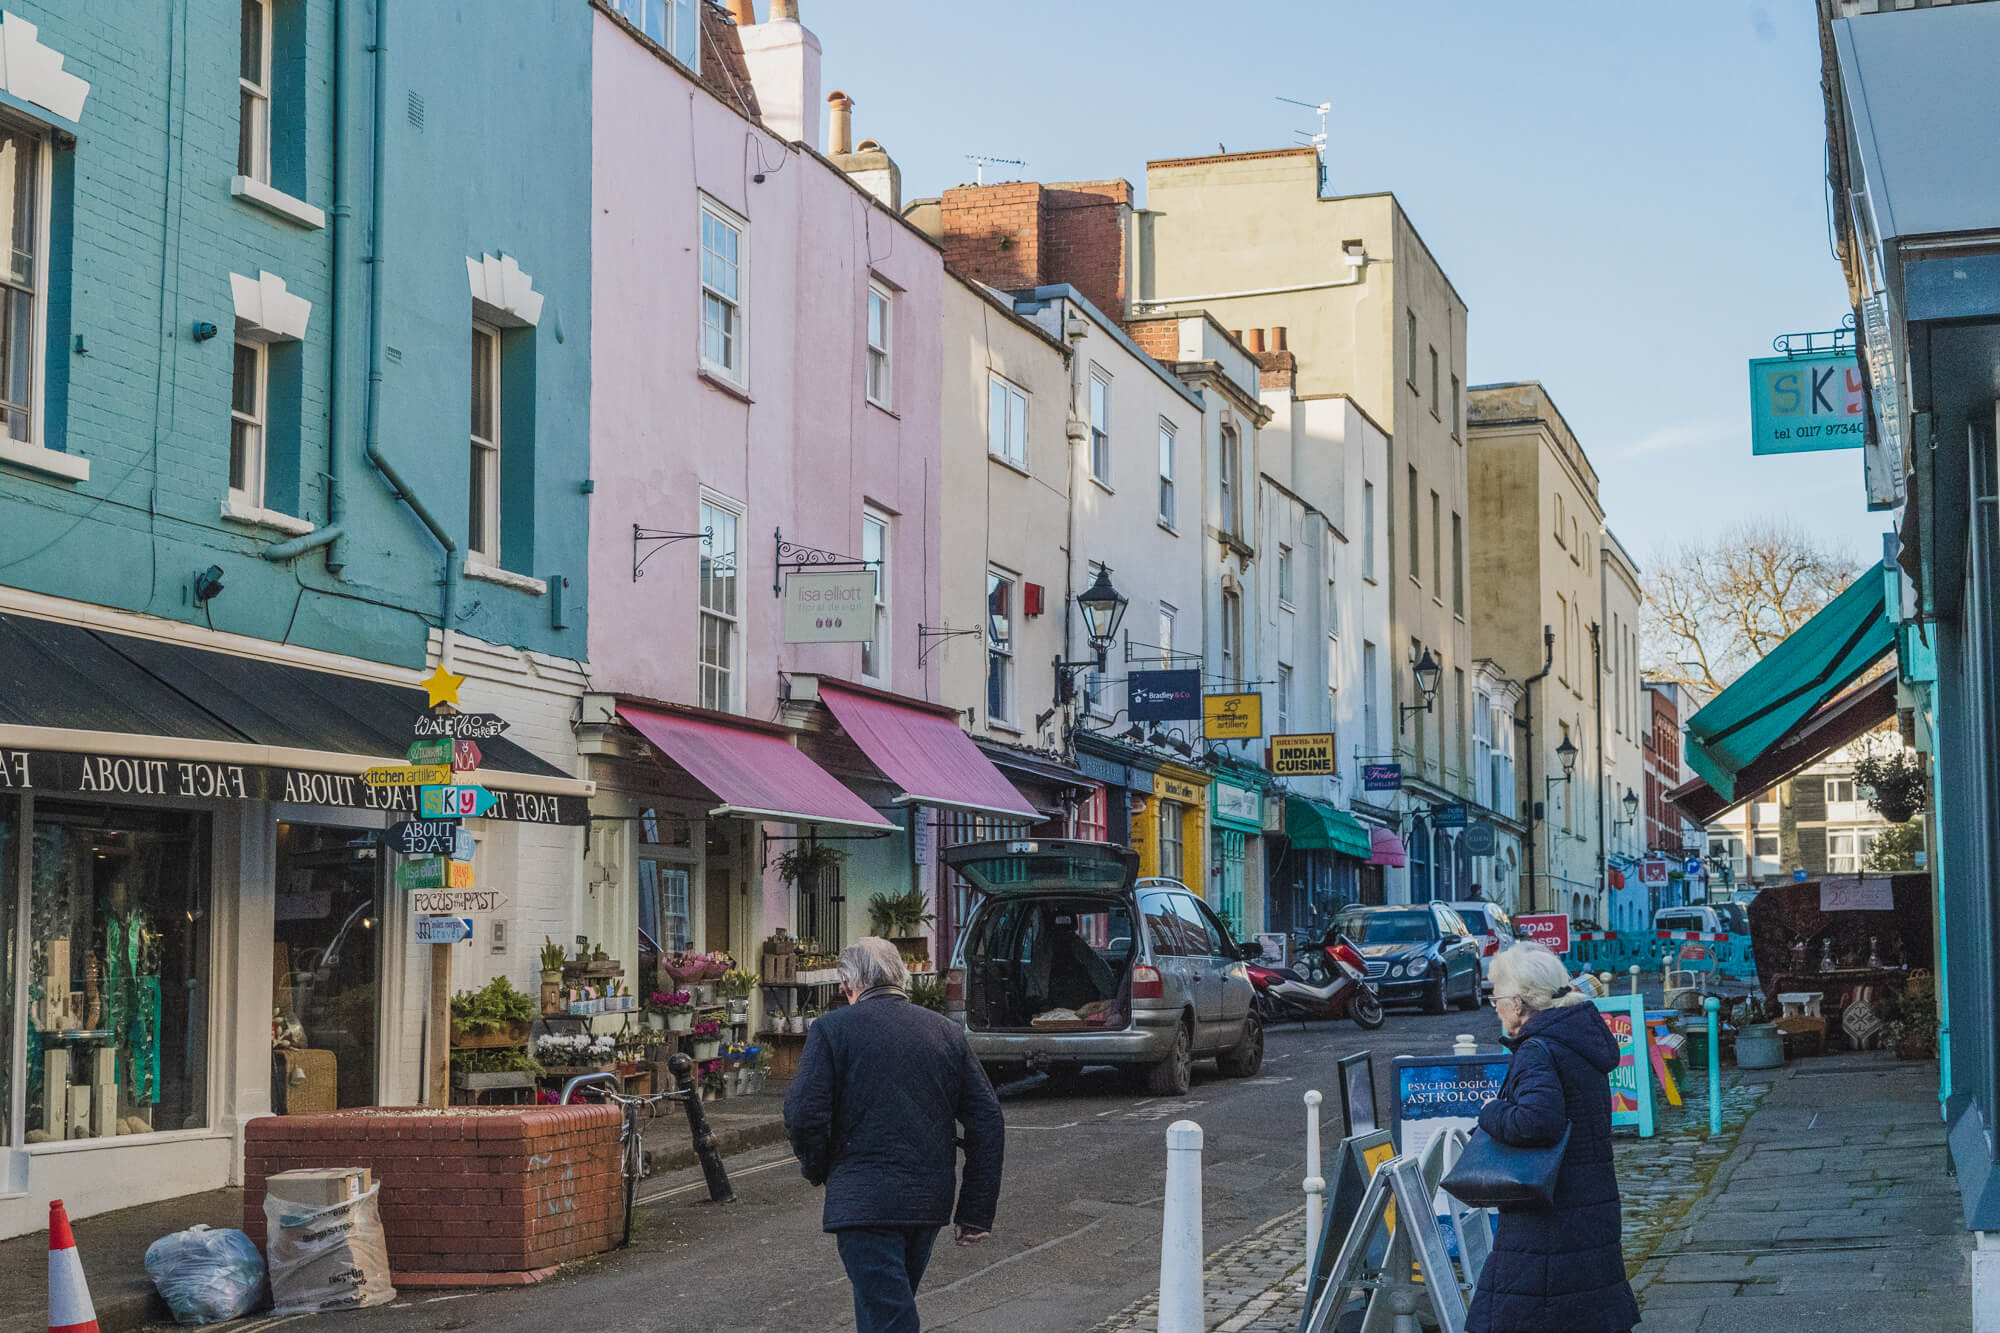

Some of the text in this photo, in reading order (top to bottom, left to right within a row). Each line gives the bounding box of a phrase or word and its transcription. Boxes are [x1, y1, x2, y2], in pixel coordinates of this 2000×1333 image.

[1774, 428, 1790, 439] tel
[1796, 425, 1821, 438] 0117
[824, 584, 861, 601] elliott
[1148, 691, 1174, 700] Bradley
[1280, 747, 1326, 760] INDIAN
[1276, 758, 1331, 772] CUISINE
[79, 755, 169, 794] ABOUT
[360, 769, 405, 785] kitchen
[406, 768, 449, 784] artillery
[283, 771, 355, 807] ABOUT
[402, 822, 454, 837] ABOUT
[414, 892, 453, 912] FOCUS
[463, 891, 499, 911] PAST
[432, 928, 461, 938] travel
[1408, 1080, 1501, 1091] PSYCHOLOGICAL
[1408, 1090, 1499, 1104] ASTROLOGY
